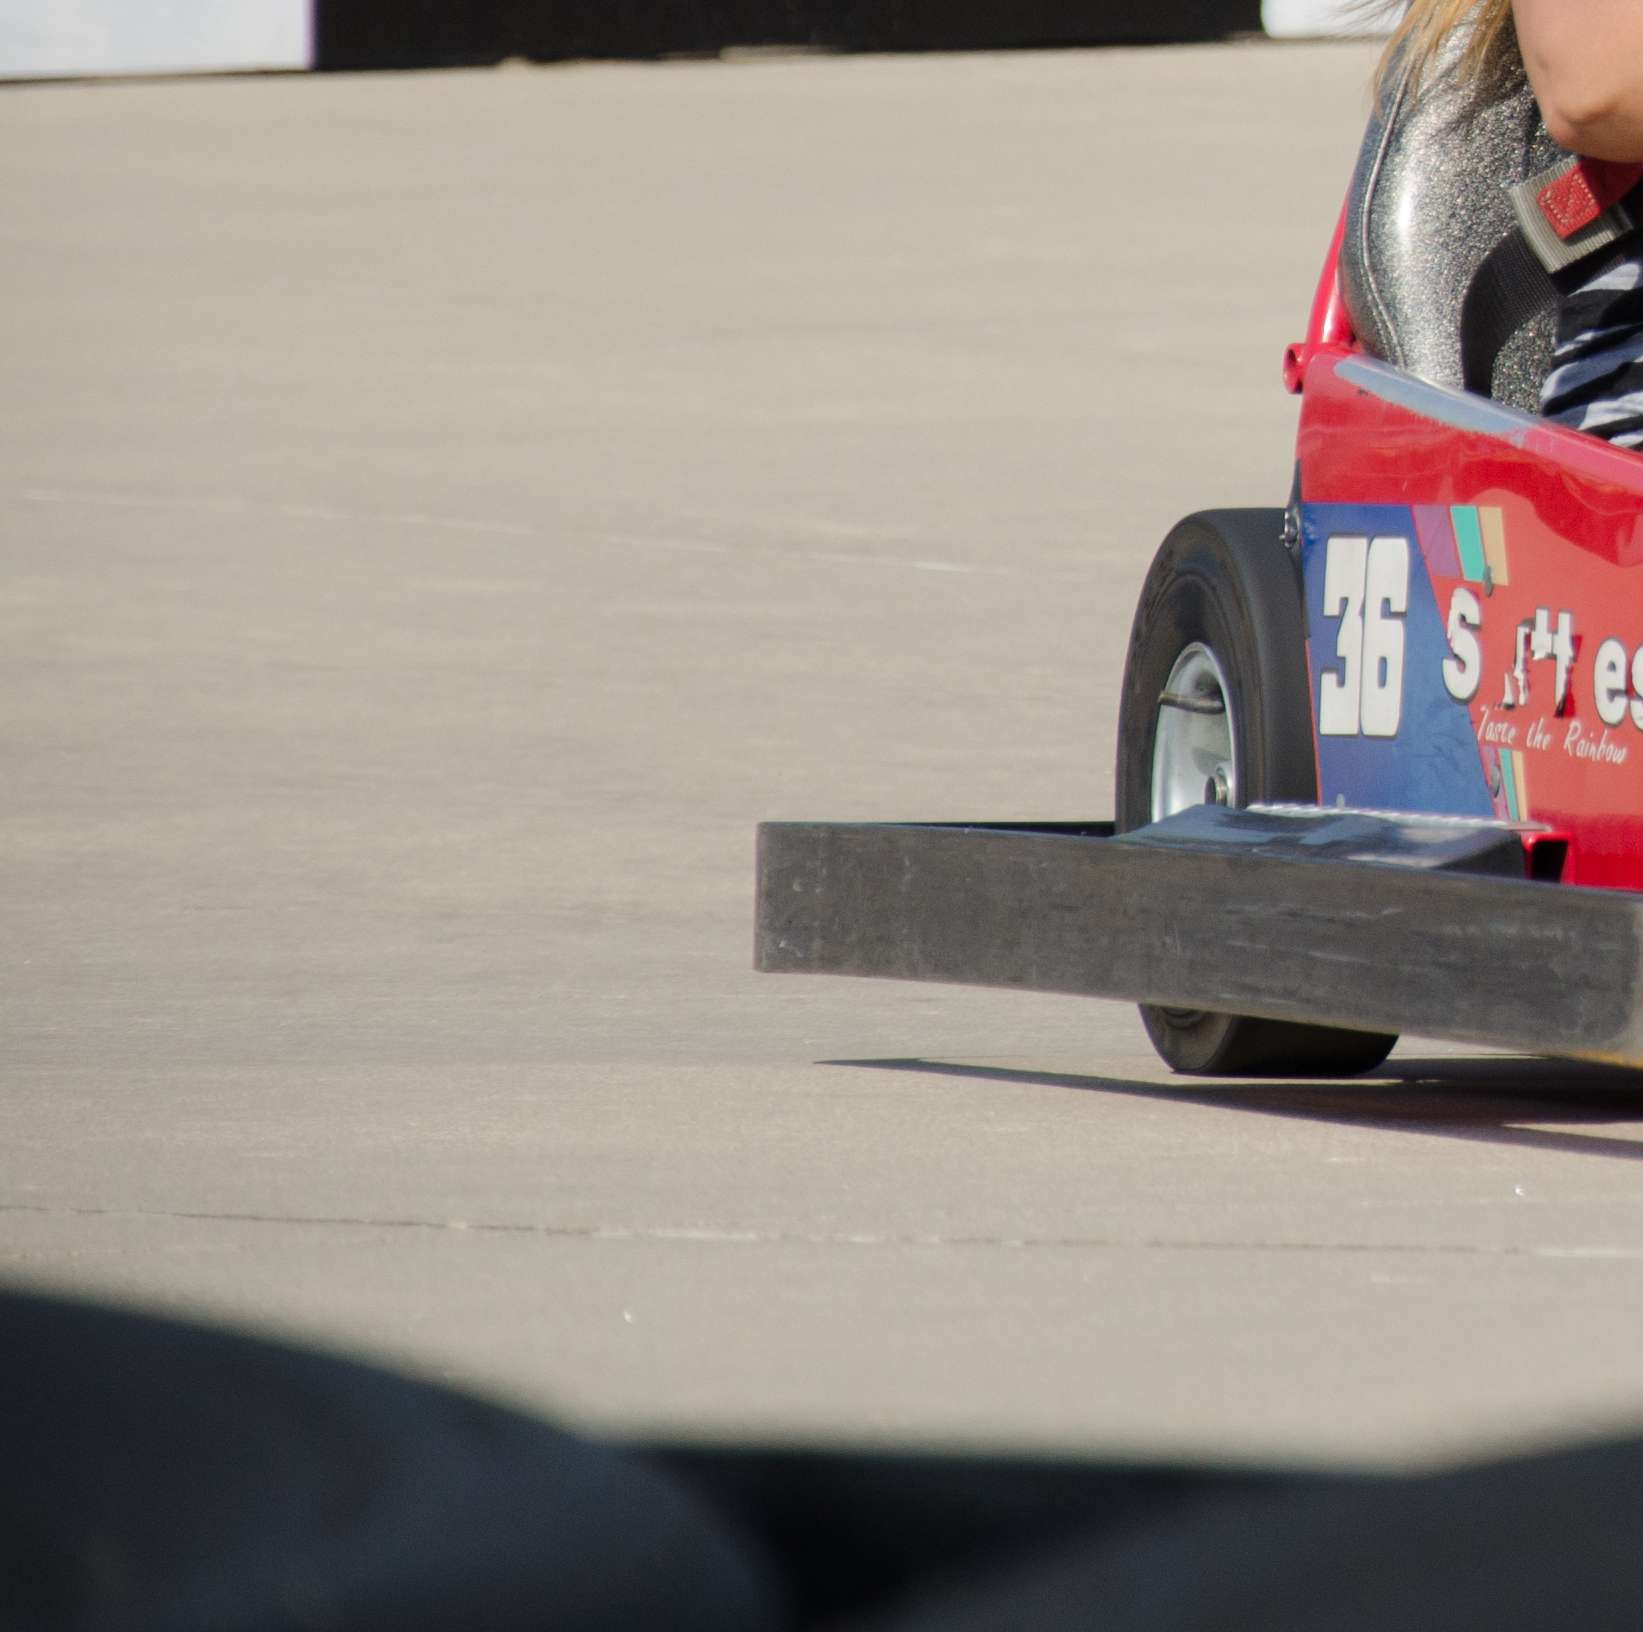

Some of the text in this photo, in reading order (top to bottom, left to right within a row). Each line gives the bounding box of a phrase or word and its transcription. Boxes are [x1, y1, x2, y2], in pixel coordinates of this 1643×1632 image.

[1319, 536, 1409, 736] 36
[1526, 718, 1552, 751] the
[1563, 720, 1627, 764] Rainbow
